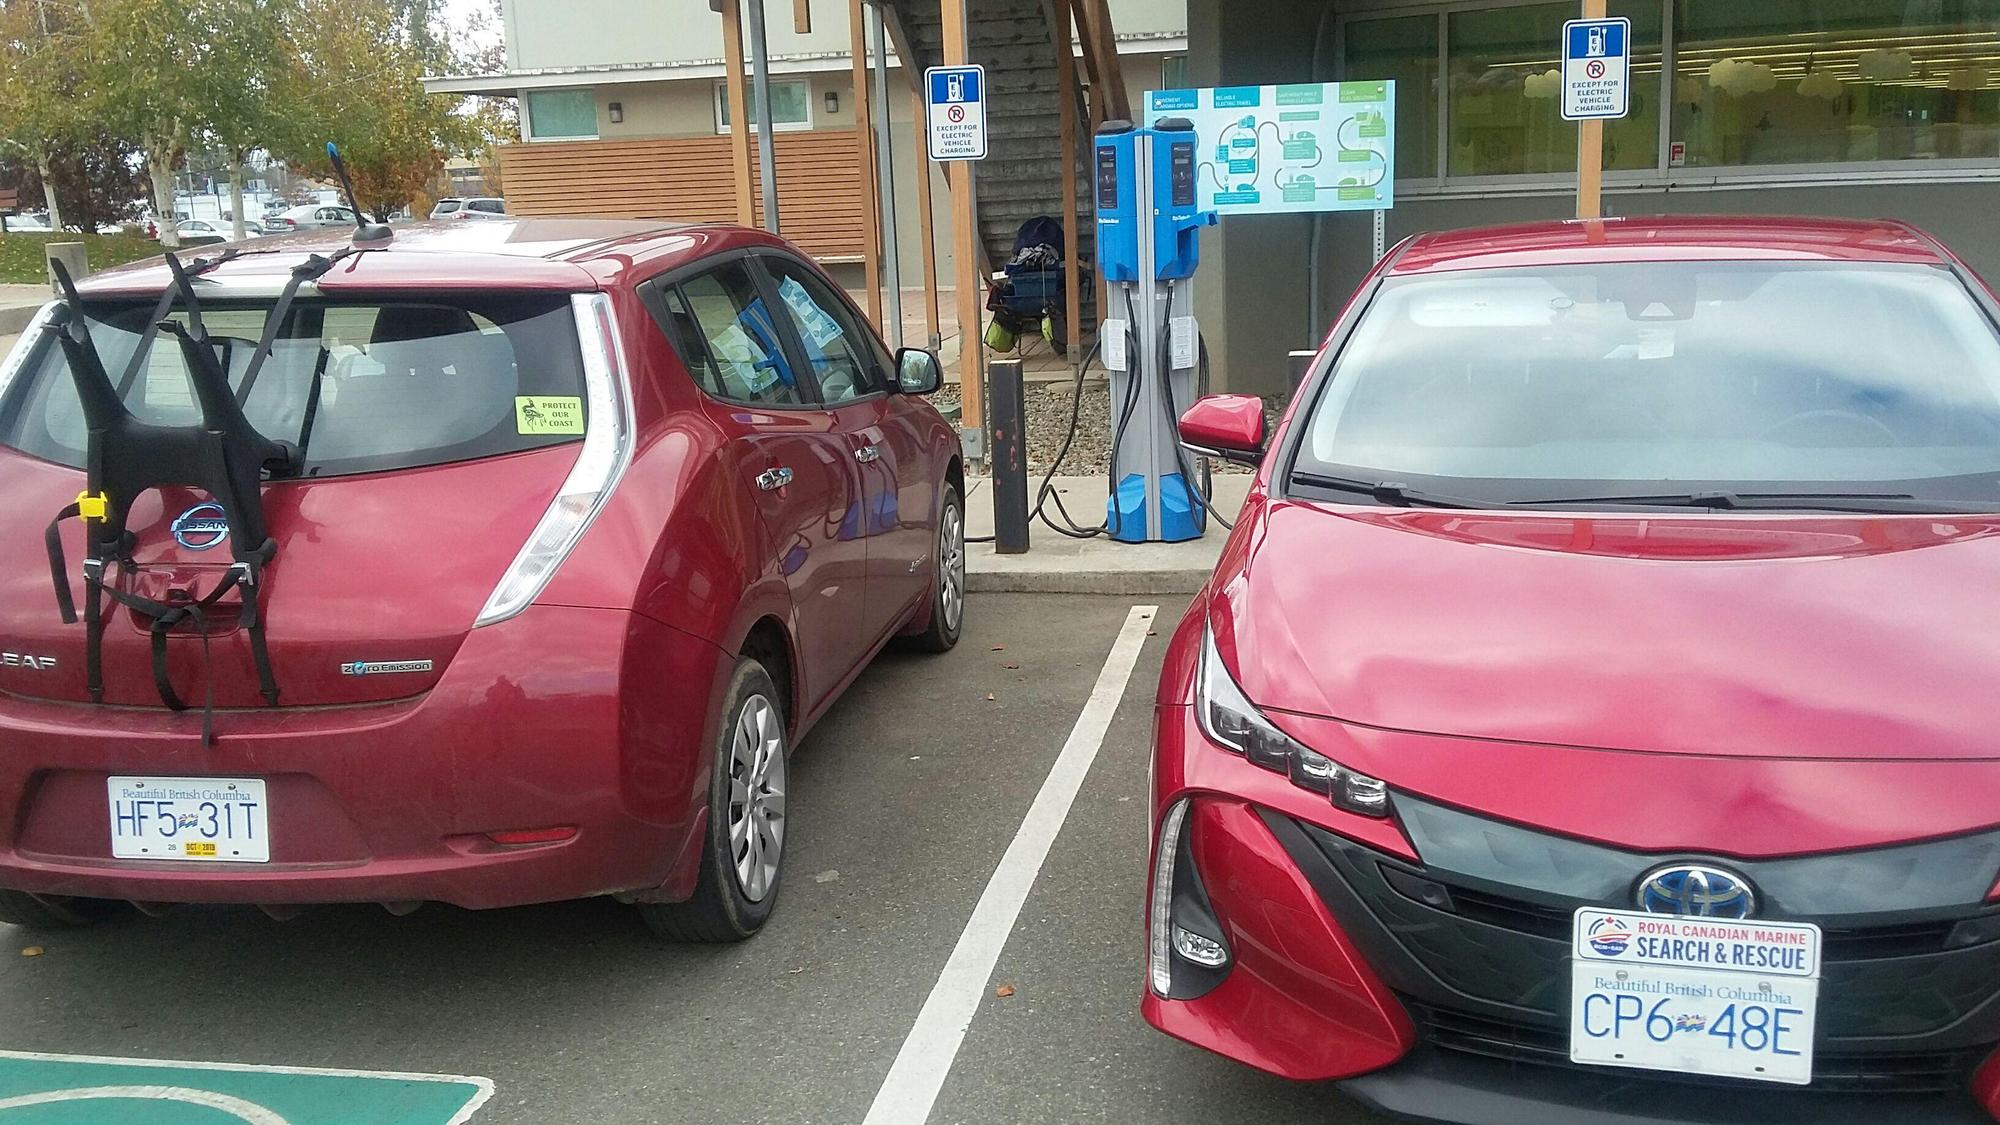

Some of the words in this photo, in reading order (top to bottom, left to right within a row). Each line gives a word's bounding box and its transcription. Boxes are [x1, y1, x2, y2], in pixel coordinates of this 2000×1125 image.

[1572, 81, 1601, 89] EXCEPT
[1577, 89, 1613, 97] ELECTRIC
[1574, 104, 1615, 112] CHARGING
[0, 652, 56, 669] EAF
[381, 662, 430, 672] Emission
[122, 788, 166, 799] Beautiful
[169, 789, 201, 800] British
[202, 790, 250, 801] Columbia
[1638, 921, 1678, 936] ROYAL
[1681, 924, 1749, 941] CANADIAN
[1754, 930, 1807, 945] MARINE
[1637, 936, 1710, 963] SEARCH
[1714, 942, 1728, 964] &
[1733, 944, 1805, 970] RESCUE
[1595, 977, 1661, 995] Beautiful
[1665, 980, 1713, 998] British
[1717, 985, 1792, 1005] Columbia
